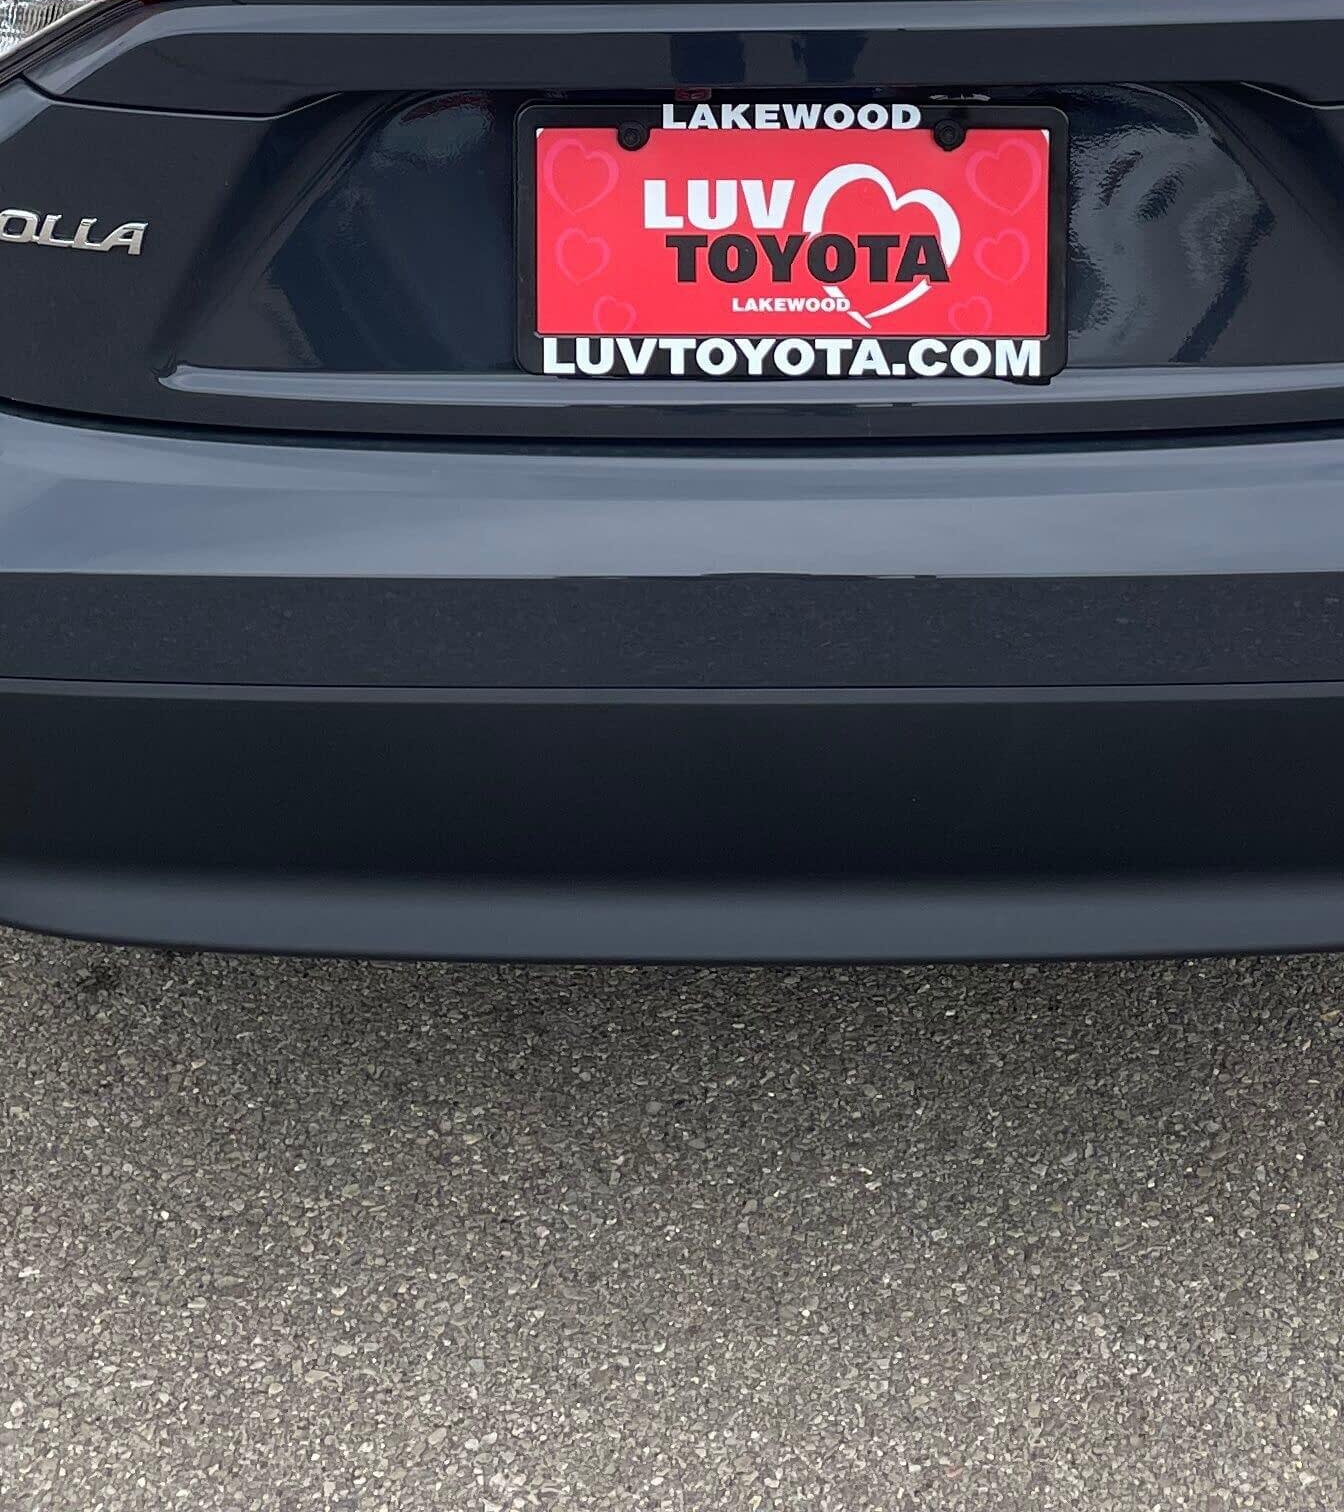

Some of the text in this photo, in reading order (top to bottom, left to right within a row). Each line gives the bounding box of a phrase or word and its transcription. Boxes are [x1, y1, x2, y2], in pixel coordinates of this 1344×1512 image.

[661, 103, 922, 131] LAKEWOOD
[643, 179, 796, 230] LUV
[665, 234, 950, 284] TOYOTA
[732, 296, 852, 313] LAKEWOOD
[542, 336, 1042, 378] LUVTOYOTA.COM
